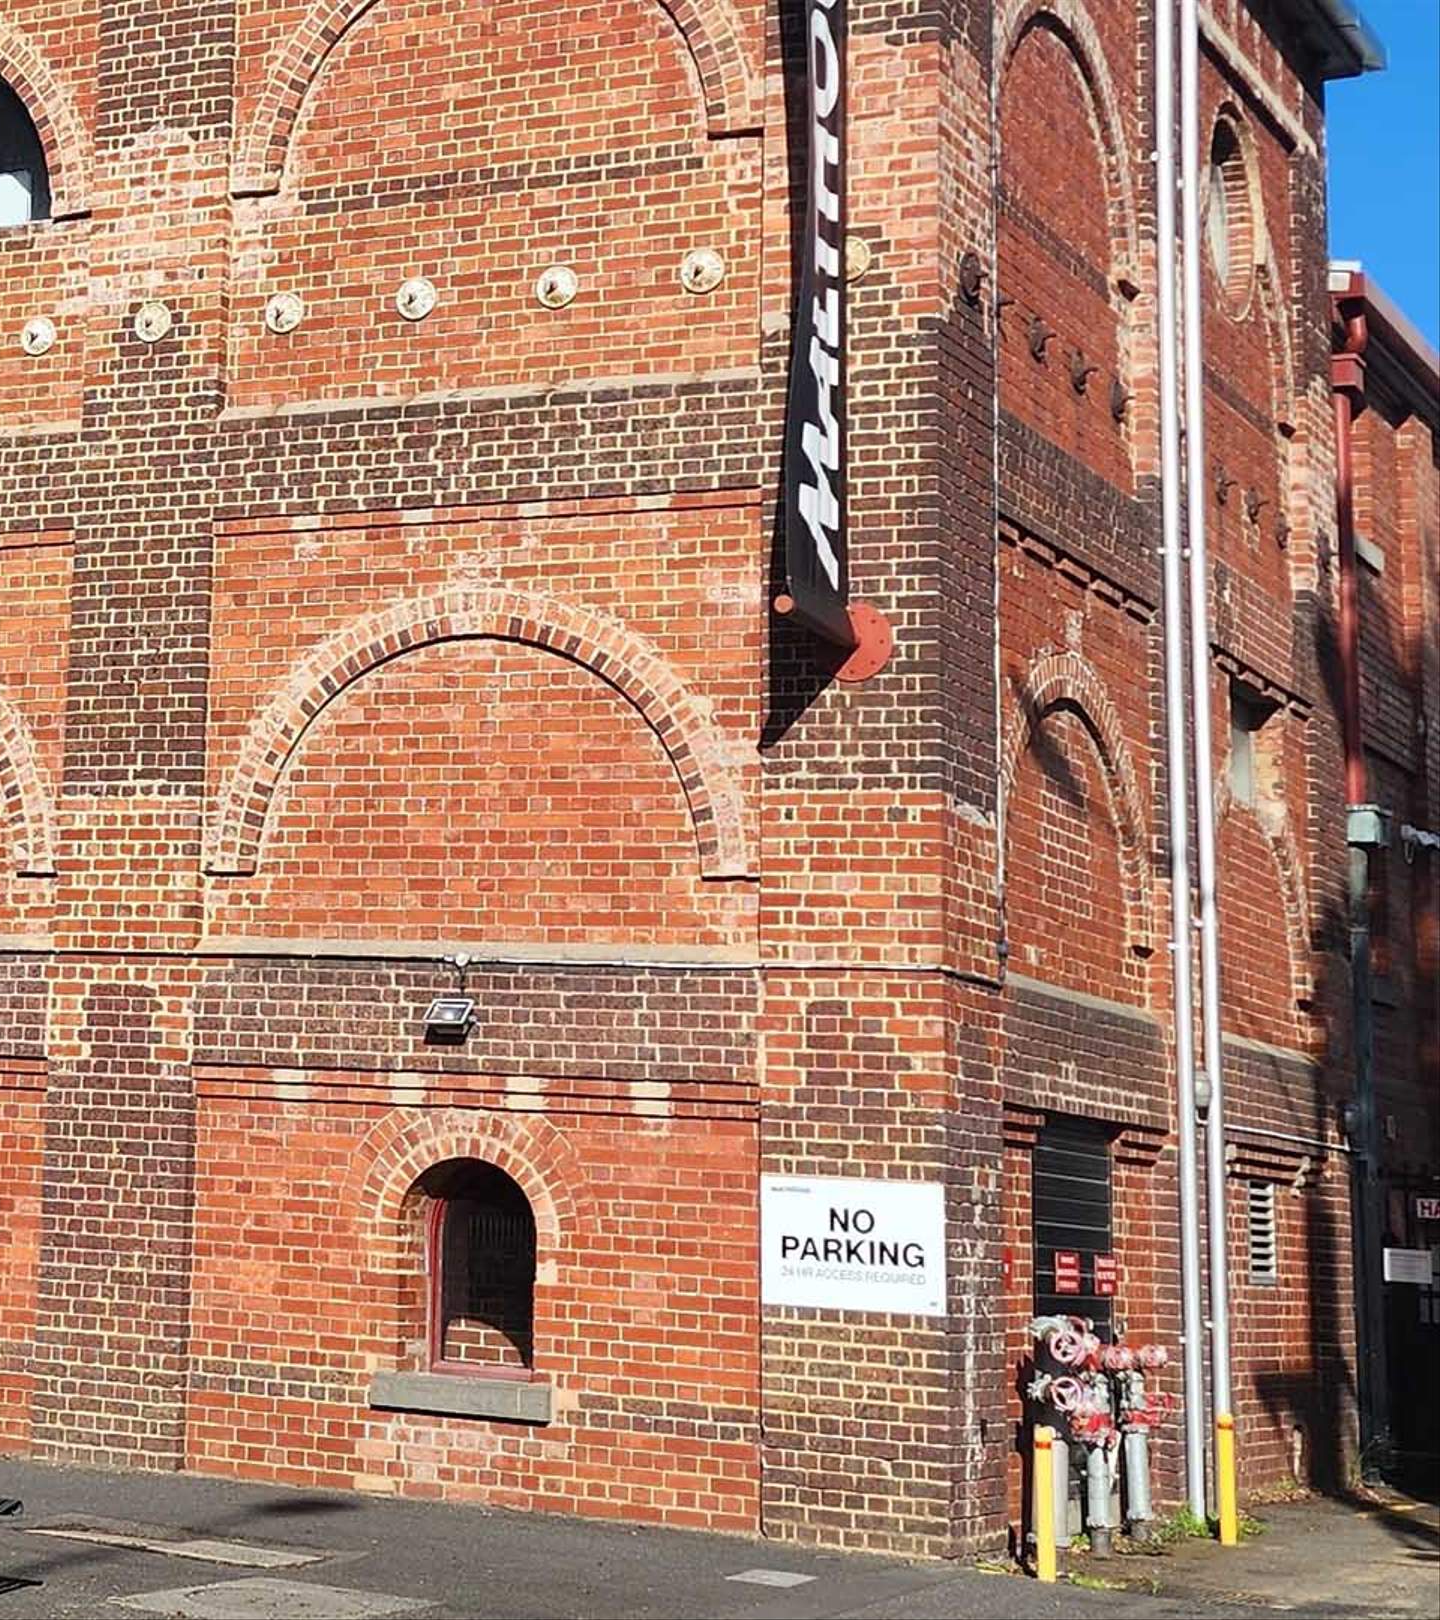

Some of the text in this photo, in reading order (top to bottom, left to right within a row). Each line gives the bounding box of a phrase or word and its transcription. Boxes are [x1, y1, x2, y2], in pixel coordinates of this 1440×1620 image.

[798, 0, 840, 591] MALTHO
[829, 1207, 875, 1234] NO
[781, 1235, 925, 1268] PARKING
[815, 1268, 864, 1281] ACCESS
[865, 1271, 927, 1286] REQUIRED
